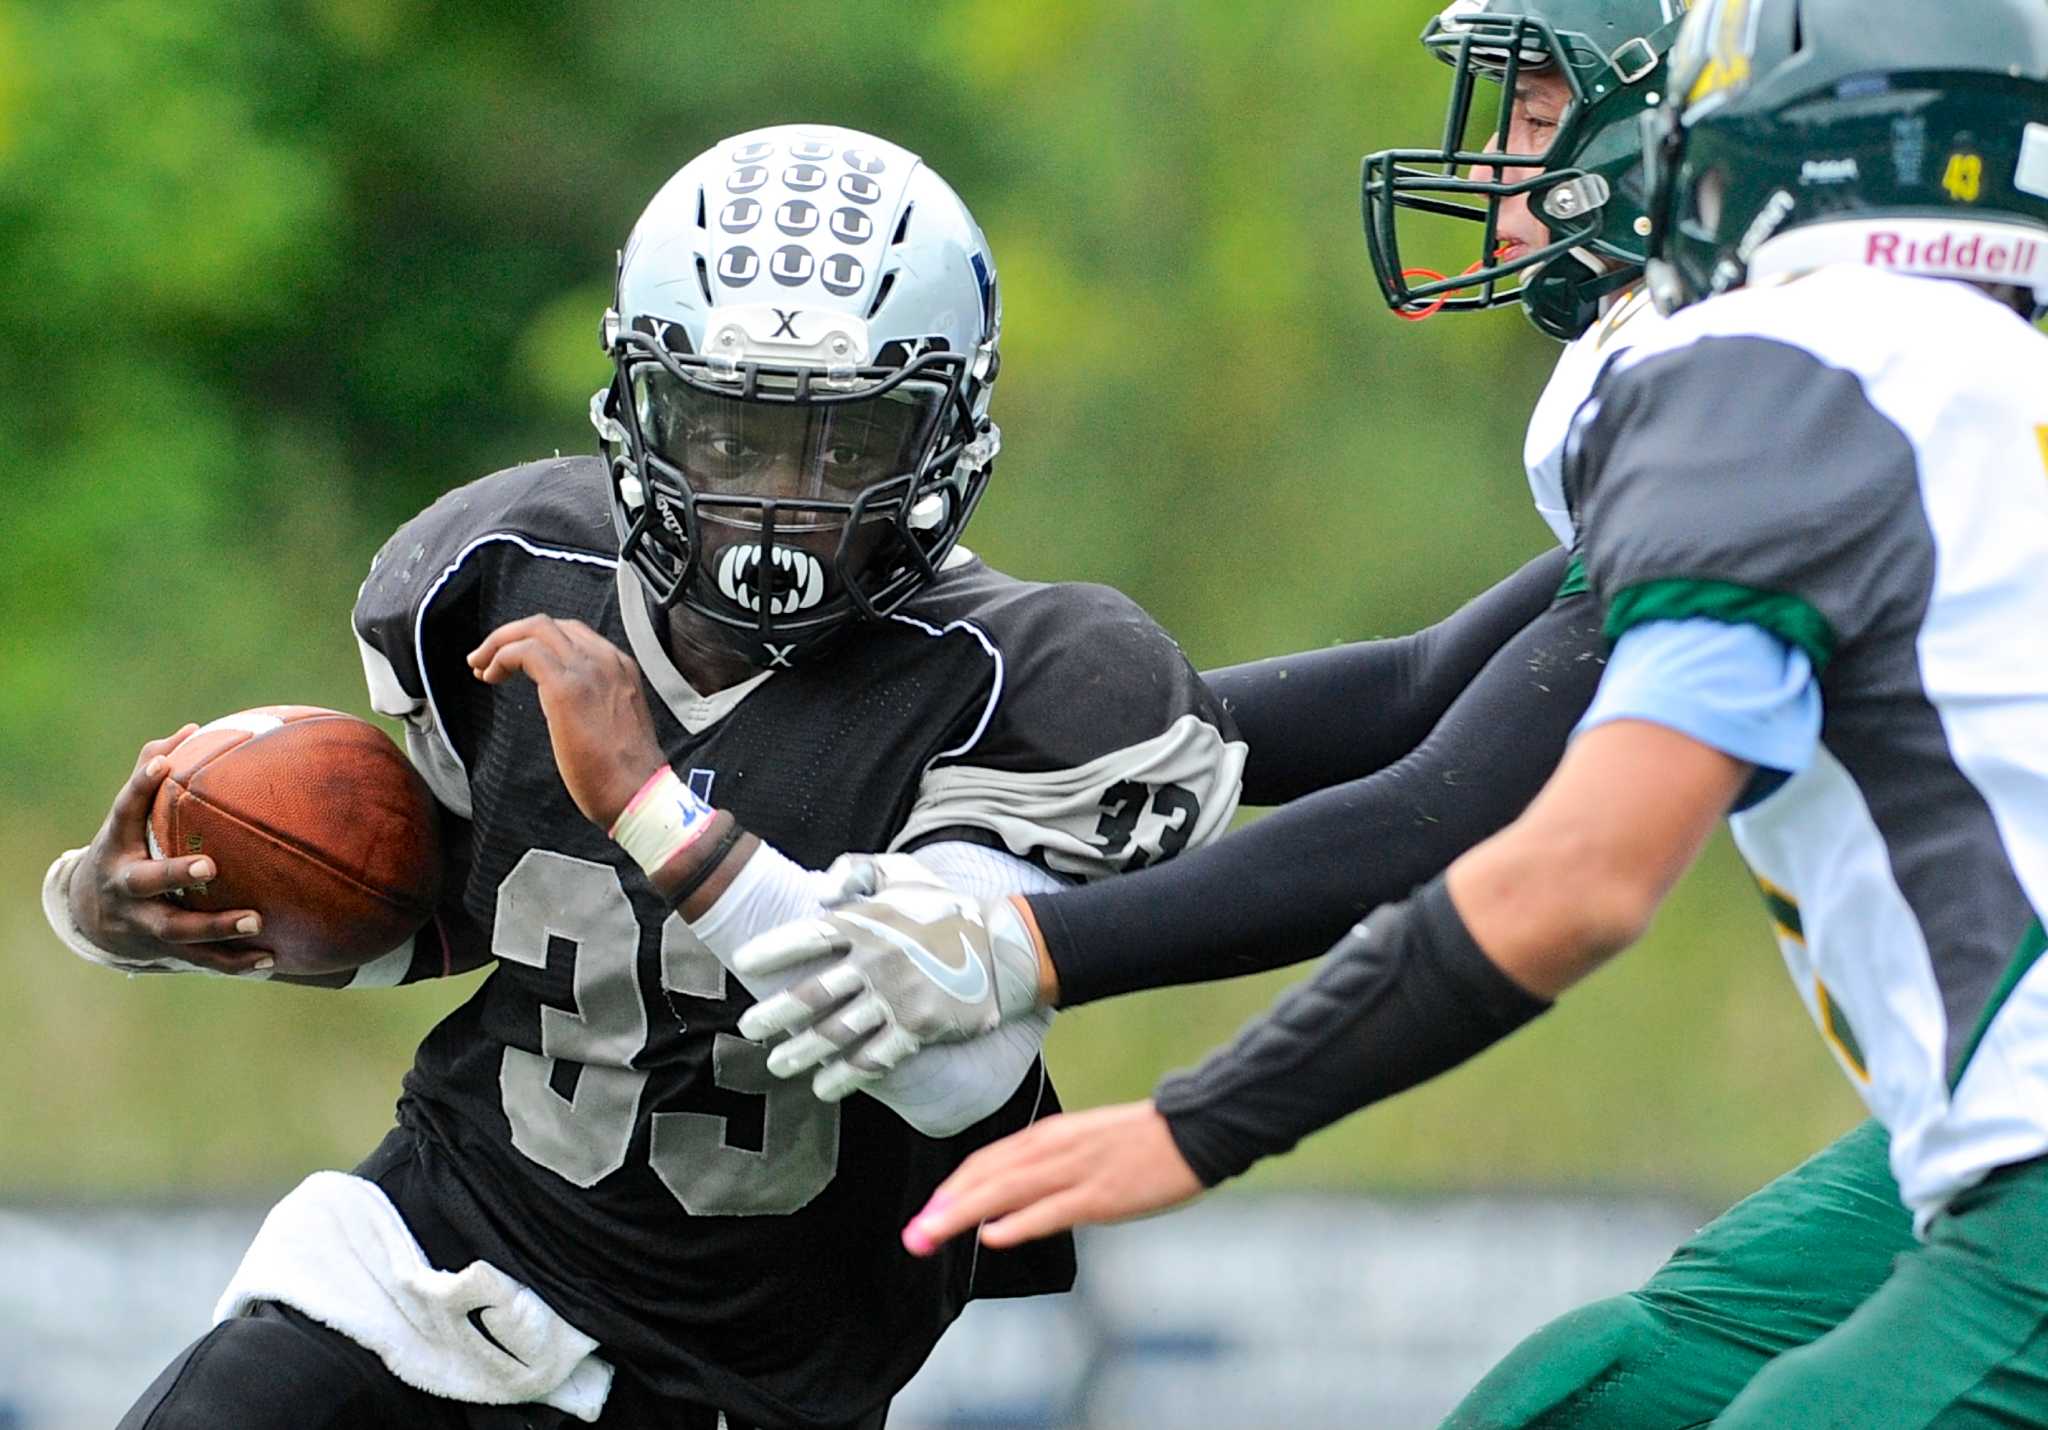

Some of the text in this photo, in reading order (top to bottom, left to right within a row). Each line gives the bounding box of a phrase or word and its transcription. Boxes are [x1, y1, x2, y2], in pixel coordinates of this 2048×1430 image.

[1865, 231, 2038, 274] Riddell
[771, 307, 804, 340] X
[762, 642, 798, 668] X
[1091, 777, 1201, 876] 33
[492, 848, 840, 1217] 33
